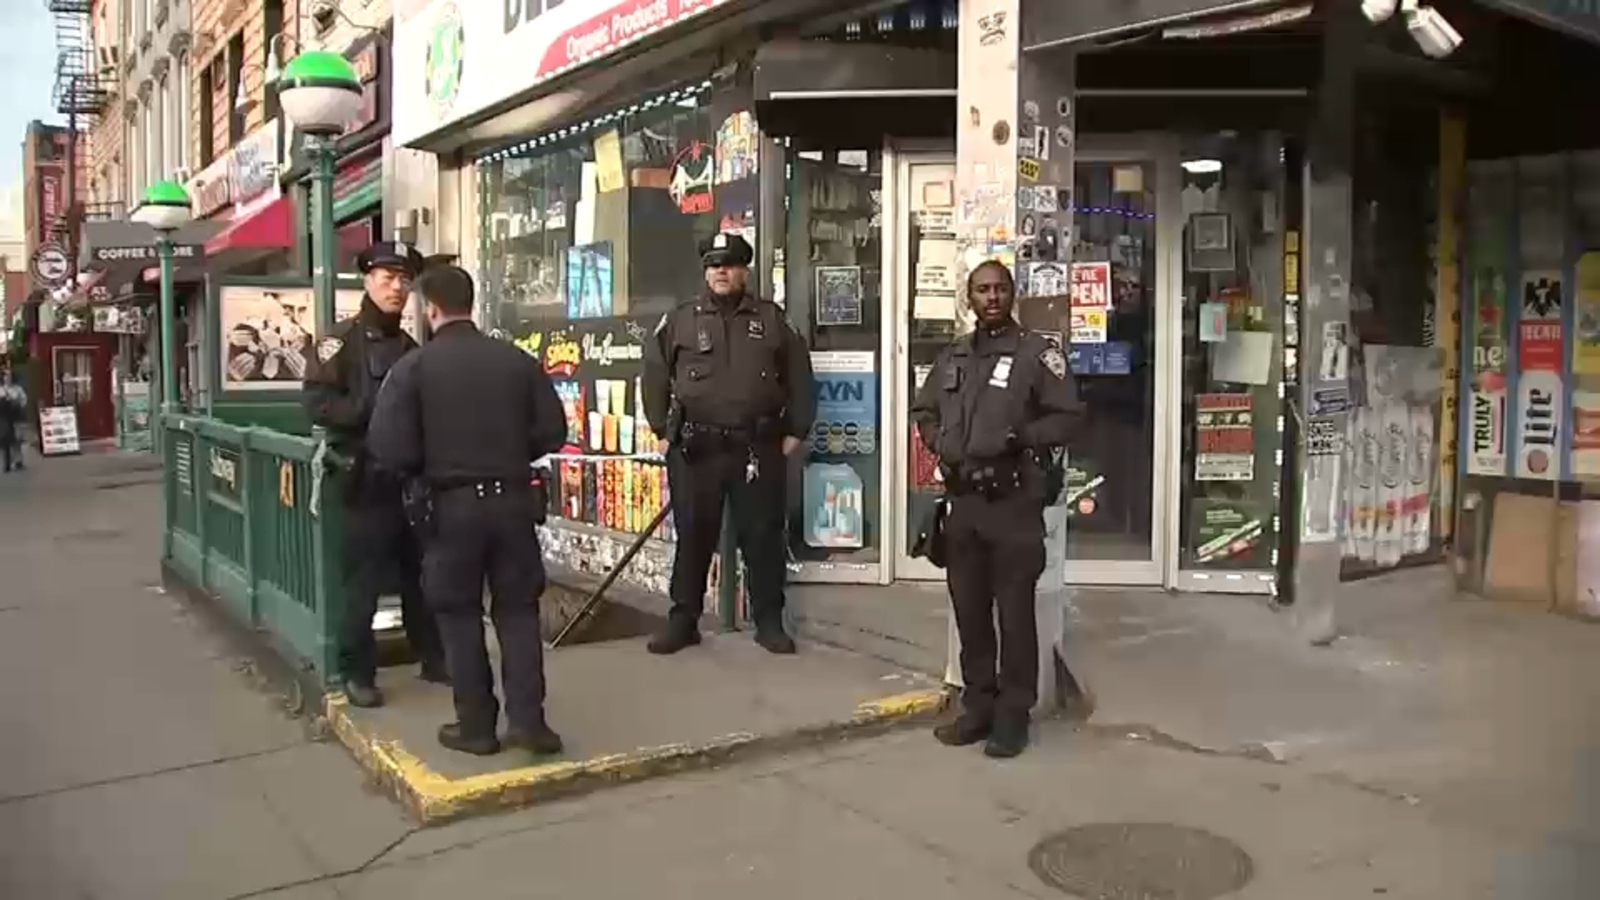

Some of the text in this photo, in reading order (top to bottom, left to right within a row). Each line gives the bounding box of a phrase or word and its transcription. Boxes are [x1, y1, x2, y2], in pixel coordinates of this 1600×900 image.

[612, 0, 668, 43] Products
[97, 247, 147, 259] COFFEE
[1072, 268, 1098, 284] E'RE
[1072, 282, 1105, 305] PEN
[1473, 395, 1493, 454] TRULY
[1523, 387, 1557, 447] Lite
